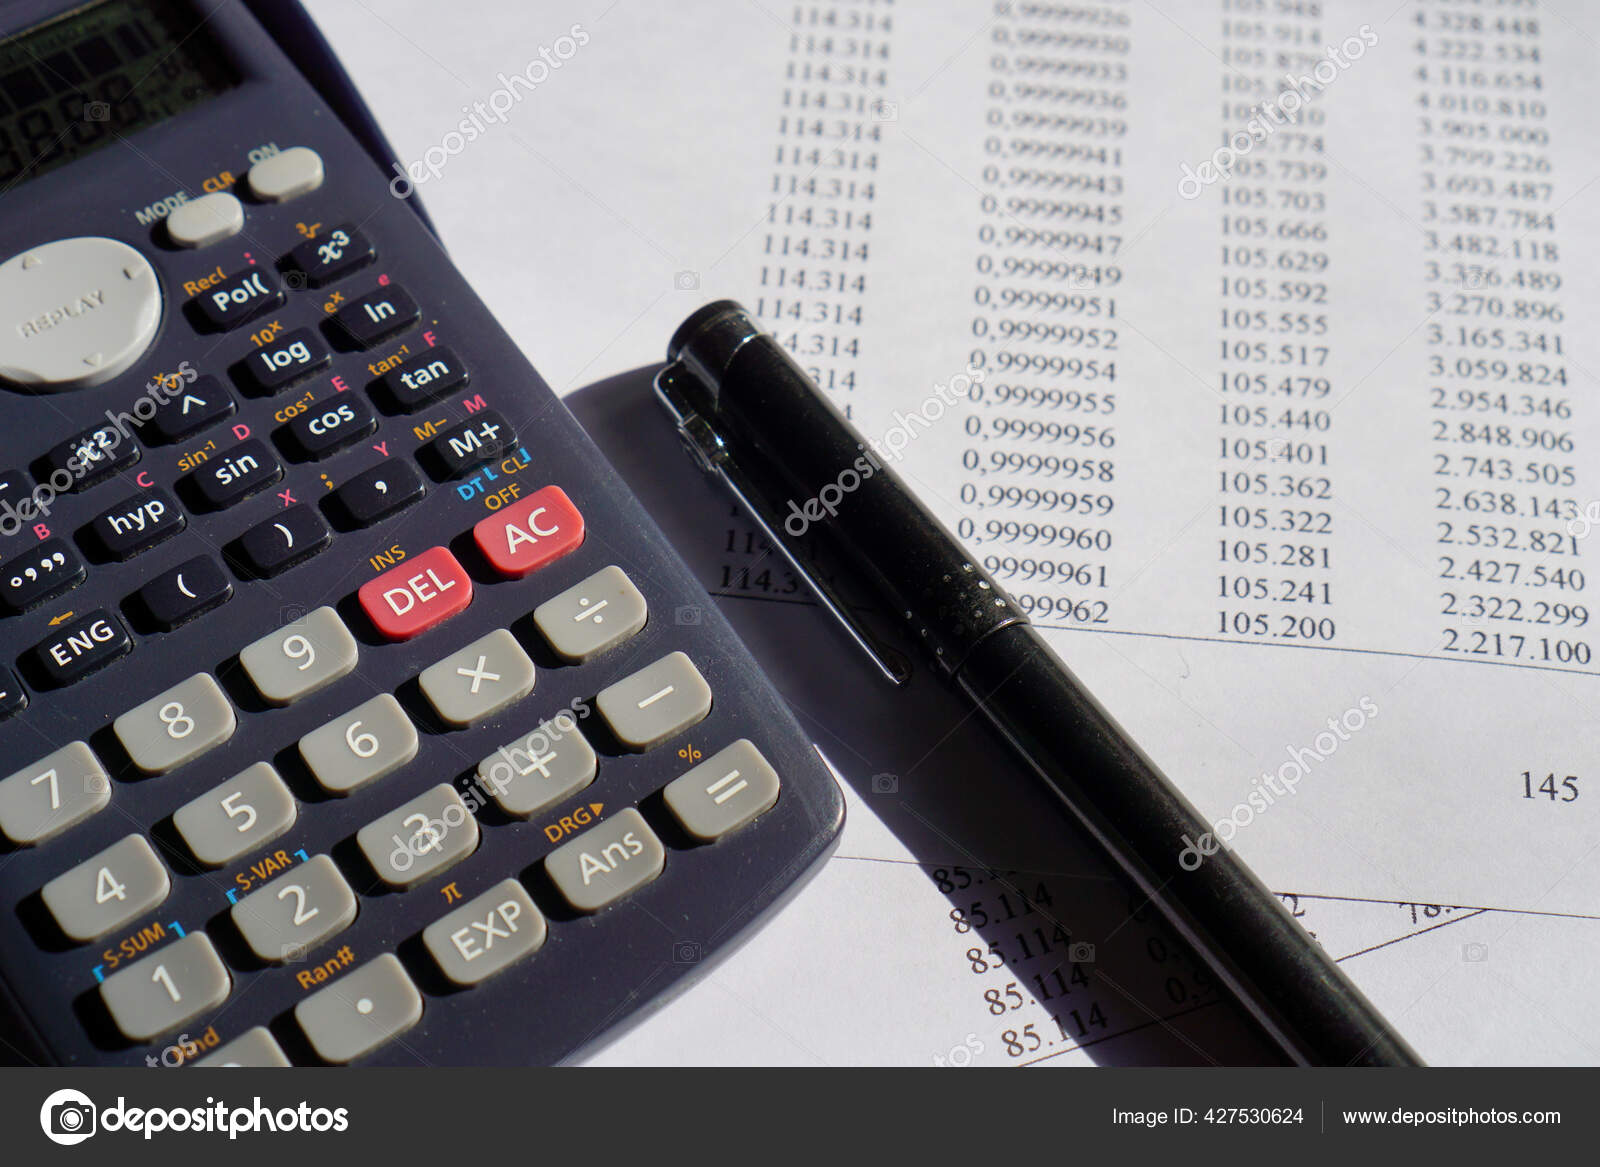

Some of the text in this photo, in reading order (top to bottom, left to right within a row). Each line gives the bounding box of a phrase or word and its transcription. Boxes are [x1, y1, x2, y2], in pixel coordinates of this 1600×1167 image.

[782, 90, 884, 116] 114.314
[778, 117, 1553, 200] 114.314 0,9999941 05.739 3.693.487
[202, 171, 236, 193] CLR
[774, 145, 1555, 232] 114.314 0,9999943 105.703 3.587.784
[767, 203, 872, 231] 114.314
[977, 225, 1123, 255] 0,9999947
[1221, 245, 1329, 272] 105.629
[771, 175, 1559, 262] 114.314 0,9999945 105.666 3.482.118
[212, 272, 270, 312] Pol(
[763, 234, 869, 262] 114.314
[1220, 276, 1328, 305] 105.592
[1427, 291, 1565, 323] 3.270.896
[17, 288, 105, 338] REPLAY
[364, 302, 396, 323] ln
[759, 266, 1564, 356] 114.314 0,9999951 105.555 3.165.341
[260, 340, 311, 372] log
[423, 331, 437, 347] F
[755, 297, 1568, 387] 114.314 0,9999952 105.517 3.059.824
[330, 375, 349, 393] E
[399, 359, 449, 390] tan
[967, 348, 1117, 383] 0,9999954
[1220, 371, 1332, 399] 105.479
[1431, 387, 1572, 420] 2.954.346
[308, 404, 355, 435] cos
[463, 394, 487, 414] M
[965, 381, 1575, 454] 0,9999955 105.440 2.848.906
[231, 424, 251, 441] D
[373, 441, 389, 456] Y
[448, 422, 500, 458] M+
[963, 415, 1577, 487] 0,9999956 105.401 2.743.505
[136, 471, 155, 488] C
[215, 455, 259, 485] sin
[456, 476, 486, 501] DT
[960, 448, 1579, 522] 0,9999958 105.362 2.638.143
[277, 488, 296, 507] X
[484, 482, 521, 511] OFF
[33, 523, 51, 541] B
[107, 500, 165, 535] hyp
[504, 507, 560, 555] AC
[958, 482, 1581, 557] 0,9999959 105.322 2.532.821
[369, 544, 406, 572] INS
[956, 516, 1586, 592] 0,9999960 105.281 2.427.540
[382, 568, 456, 616] DEL
[1217, 575, 1333, 606] 105.241
[1440, 591, 1590, 628] 2.322.299
[49, 620, 115, 667] ENG
[282, 634, 316, 671] 9
[1216, 610, 1337, 642] 105.200
[1441, 627, 1592, 665] 2.217.100
[159, 701, 195, 739] 8
[345, 720, 379, 758] 6
[677, 743, 703, 764] %
[31, 768, 60, 810] 7
[1520, 770, 1579, 803] 145
[220, 791, 257, 832] 5
[543, 808, 590, 843] DRG
[235, 849, 292, 891] S-VAR
[579, 831, 644, 885] Ans
[95, 867, 127, 905] 4
[277, 884, 319, 926] 2
[949, 881, 1053, 934] 85.114
[103, 922, 166, 968] S-SUM
[450, 900, 521, 961] EXP
[966, 926, 1071, 974] 85.114
[152, 965, 181, 1002] 1
[296, 945, 355, 989] Ran#
[983, 963, 1089, 1016] 85.114
[1001, 1001, 1108, 1058] 85.114
